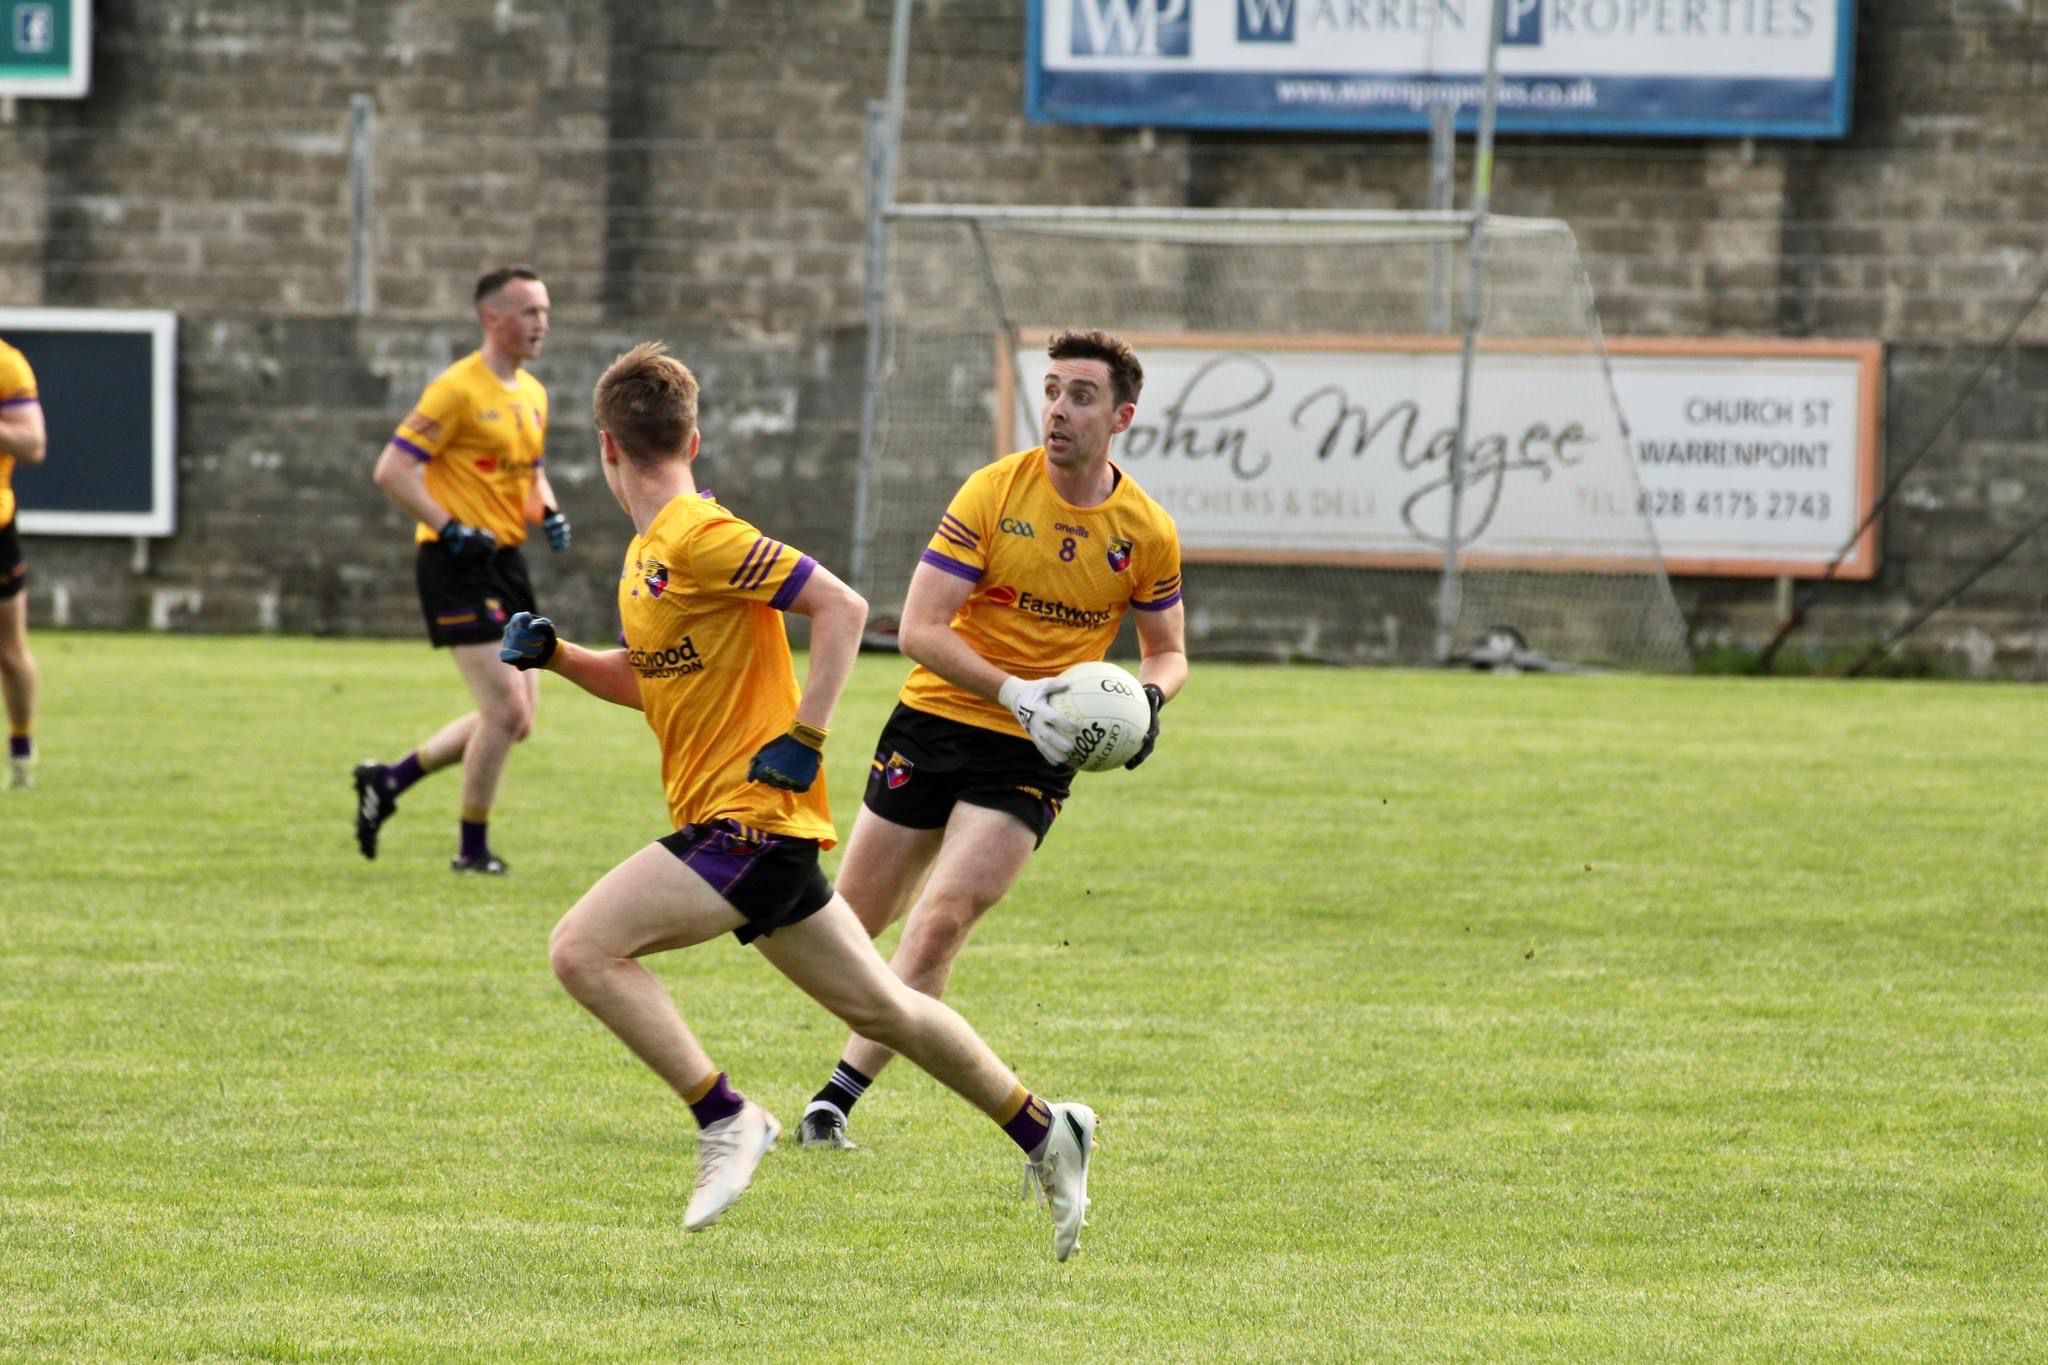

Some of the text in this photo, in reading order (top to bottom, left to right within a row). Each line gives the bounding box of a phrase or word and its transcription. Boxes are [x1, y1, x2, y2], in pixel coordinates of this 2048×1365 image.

[1239, 0, 1815, 39] WARREN PROPERTIES
[1686, 397, 1832, 426] CHURCH ST
[1115, 352, 1596, 548] ohn Magee
[1638, 440, 1831, 468] WARRENPOINT
[1696, 490, 1756, 518] 4175
[1768, 490, 1831, 519] 2743
[1059, 537, 1077, 562] 8
[1018, 591, 1112, 625] Eastwood
